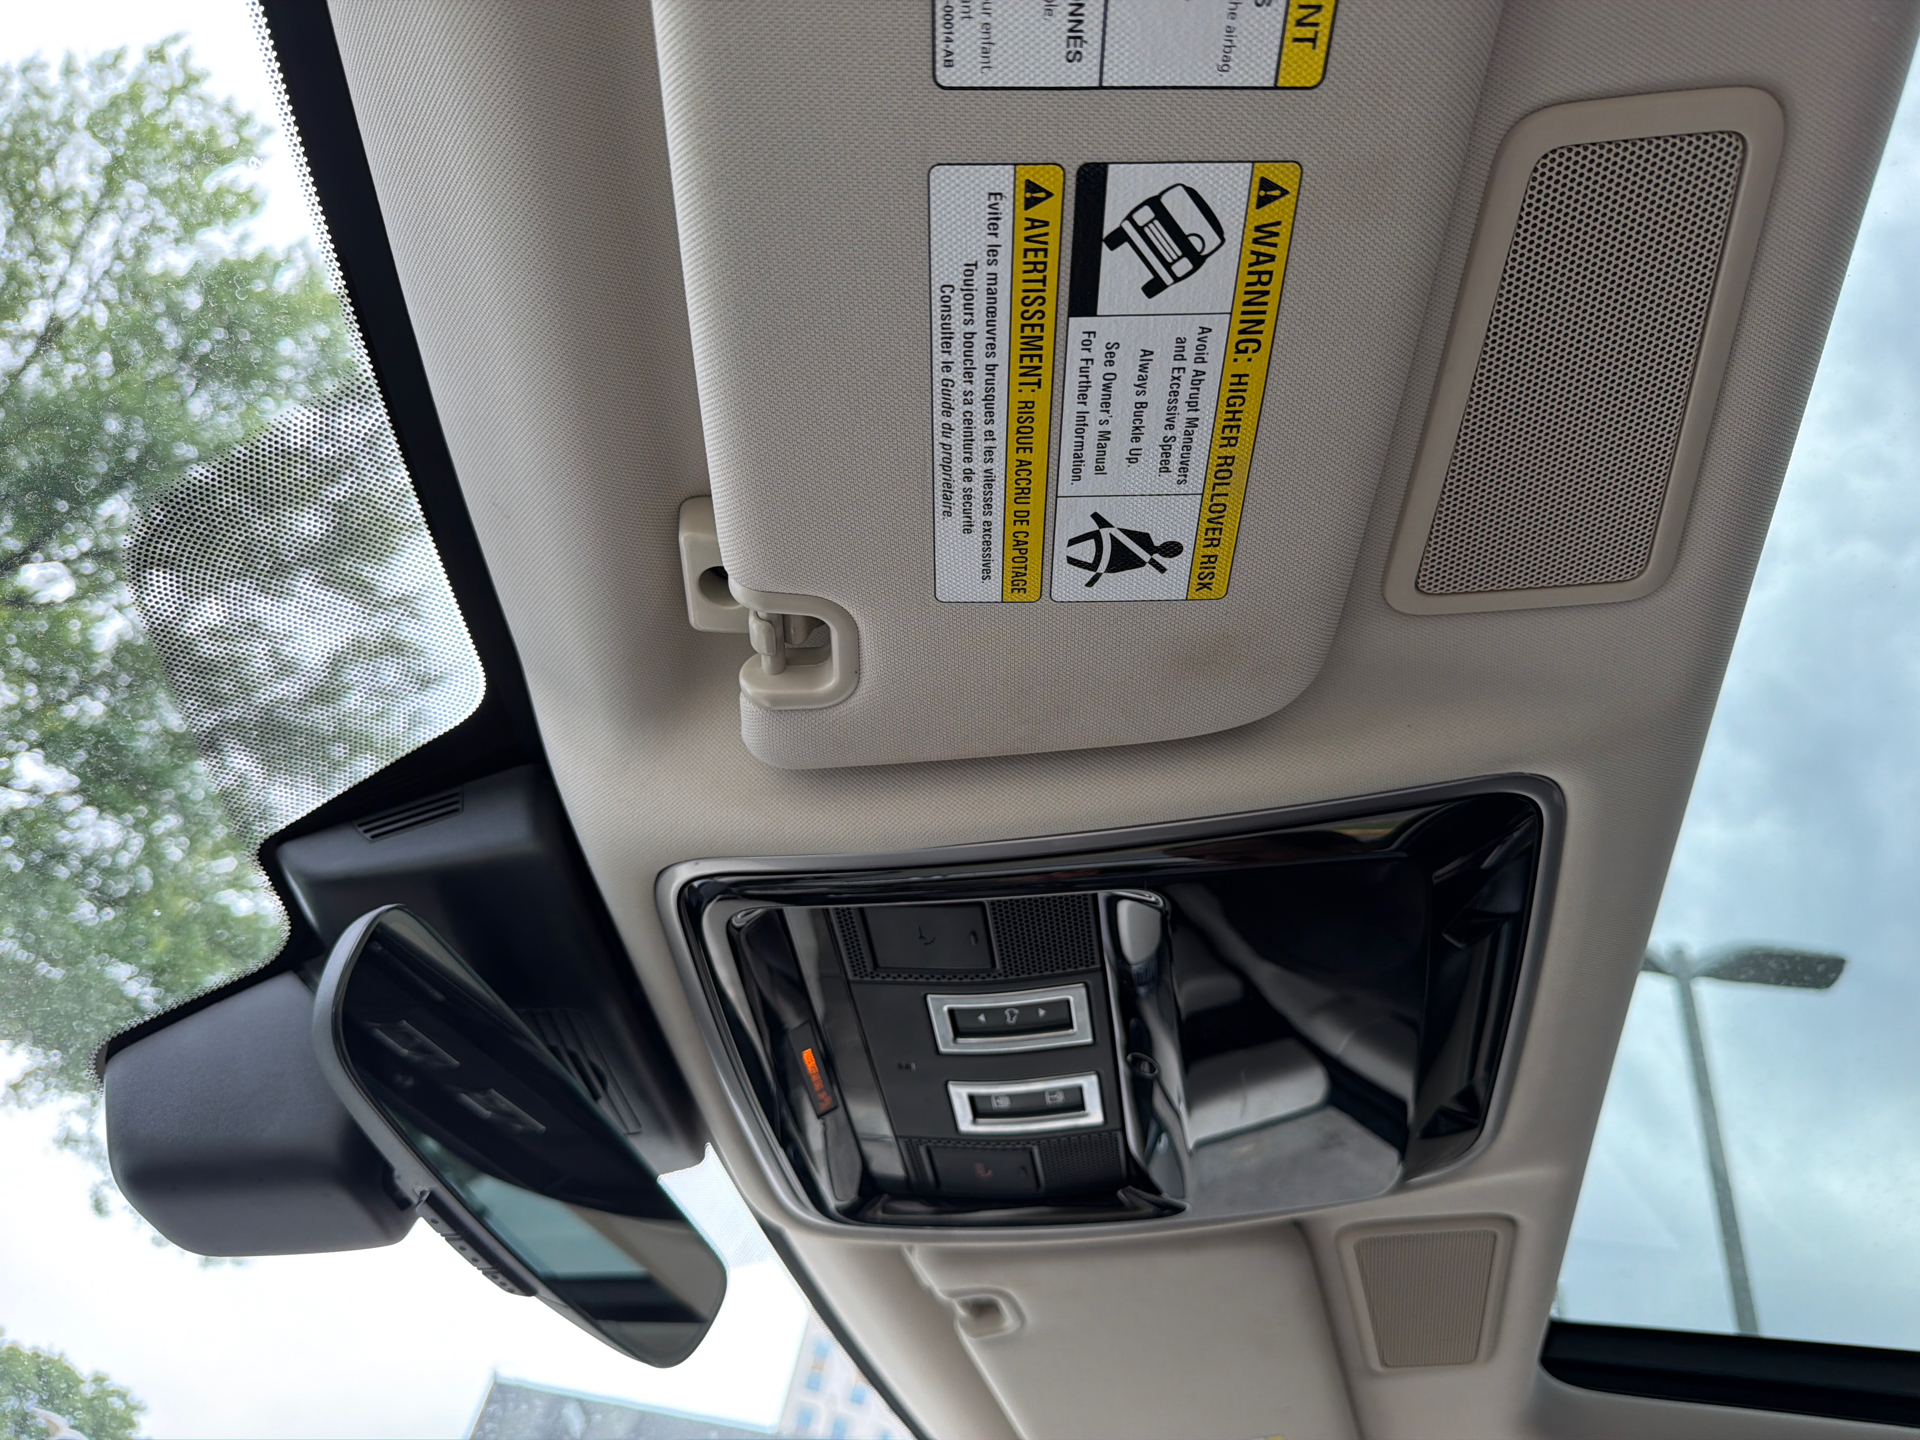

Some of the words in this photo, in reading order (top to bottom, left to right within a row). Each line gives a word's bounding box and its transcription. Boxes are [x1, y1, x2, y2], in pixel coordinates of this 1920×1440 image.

[943, 0, 955, 69] -00014-AB
[1216, 24, 1238, 77] airbag,
[987, 192, 1007, 238] Éviter
[986, 244, 1002, 266] les
[960, 261, 978, 325] Toujours
[985, 272, 999, 358] manœuvres
[1018, 217, 1050, 393] AVERTISSEMENT:
[1232, 220, 1283, 363] WARNING:
[940, 284, 955, 355] Consulter
[1080, 331, 1096, 353] For
[940, 360, 955, 373] le
[963, 331, 977, 385] boucler
[1103, 342, 1120, 367] See
[1172, 337, 1187, 361] and
[1193, 326, 1212, 364] Avoid
[982, 364, 999, 425] brusques
[1076, 358, 1094, 406] Further
[1133, 349, 1154, 396] Always
[1184, 369, 1206, 412] Abrupt
[941, 376, 955, 418] Guide
[963, 390, 974, 405] sa
[1098, 372, 1117, 425] Owner's
[1163, 366, 1186, 431] Excessive
[1217, 373, 1250, 448] HIGHER
[941, 422, 956, 438] du
[963, 411, 976, 463] ceinture
[983, 429, 997, 441] et
[1015, 401, 1035, 454] RISQUE
[1130, 402, 1148, 443] Buckle
[983, 445, 997, 463] les
[1070, 411, 1090, 485] Information.
[1094, 430, 1111, 475] Manual
[1125, 448, 1143, 468] Up.
[1158, 435, 1177, 477] Speed.
[1176, 417, 1200, 485] Maneuvers
[963, 467, 976, 482] de
[982, 467, 996, 516] vitesses
[1013, 459, 1033, 505] ACCRU
[963, 487, 975, 534] sécurité
[1012, 510, 1030, 527] DE
[1199, 455, 1236, 549] ROLLOVER
[981, 520, 993, 583] excessives.
[1010, 530, 1030, 594] CAPOTAGE
[1195, 555, 1219, 592] RISK
